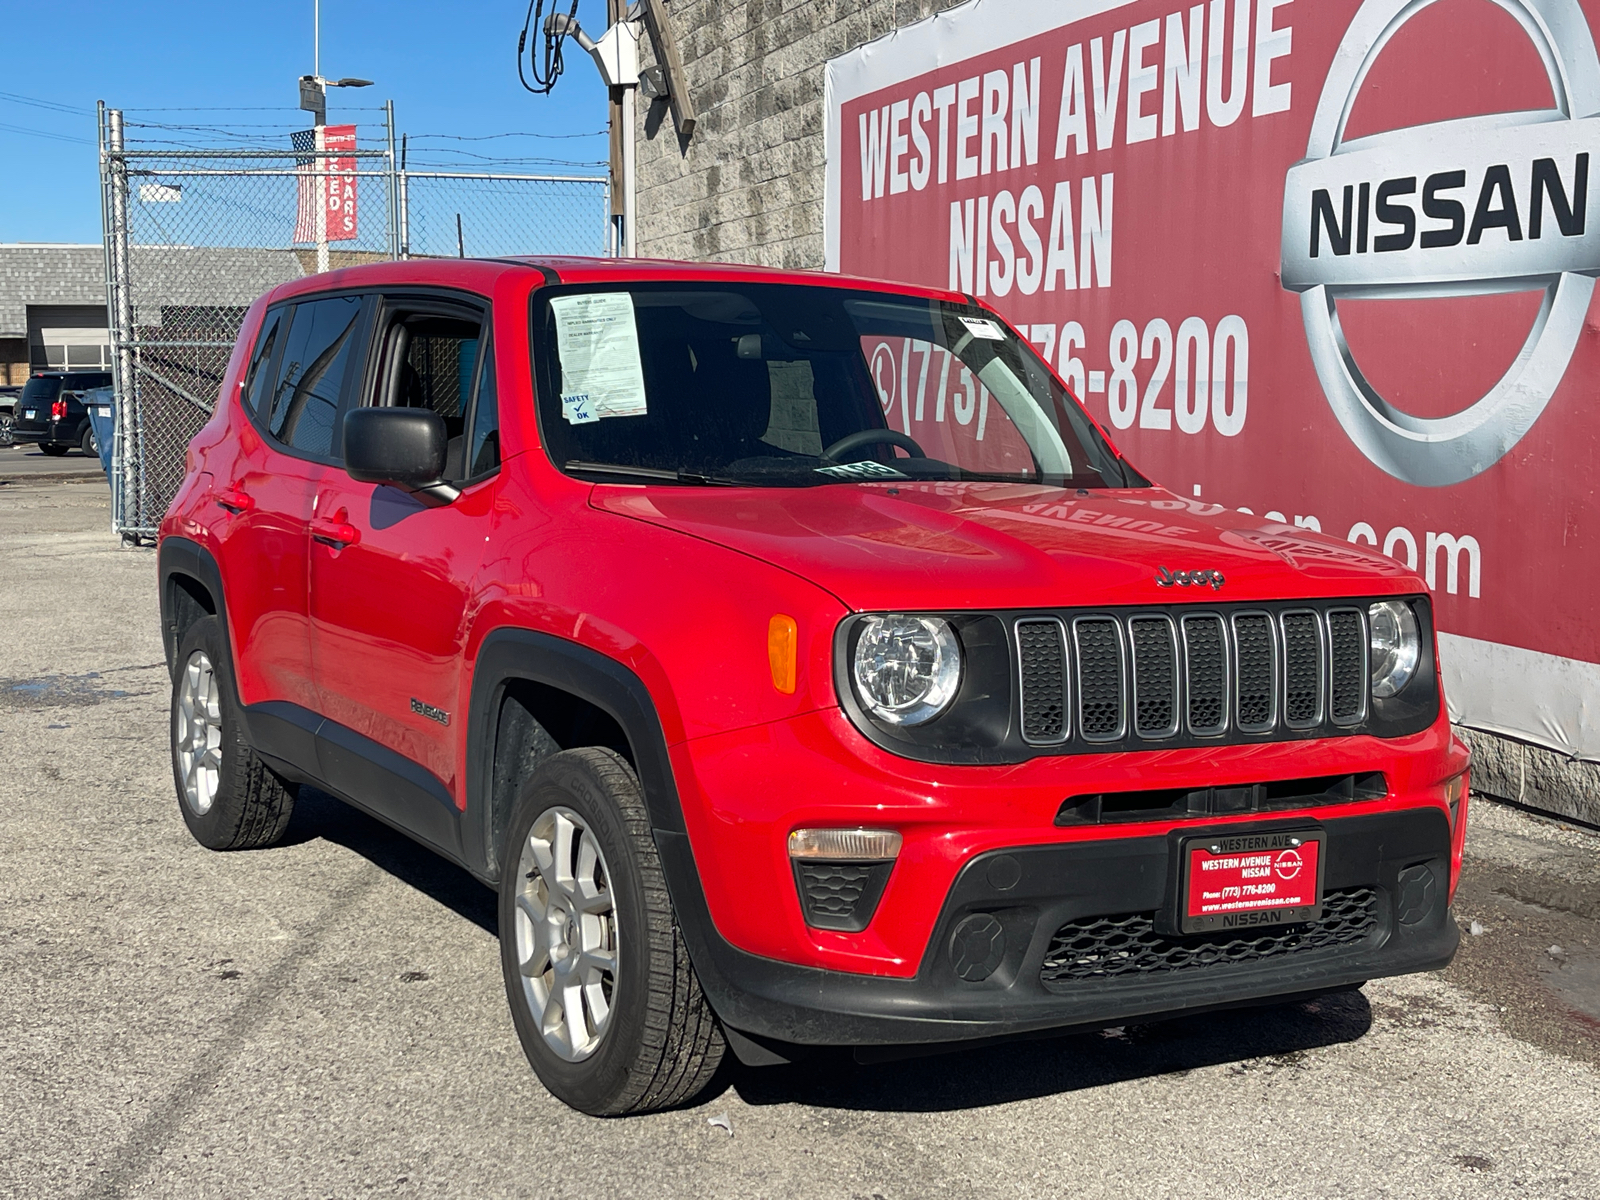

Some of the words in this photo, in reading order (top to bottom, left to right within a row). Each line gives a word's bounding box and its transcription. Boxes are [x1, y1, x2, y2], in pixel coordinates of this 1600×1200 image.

[859, 57, 1041, 201] WESTERN
[1055, 0, 1294, 159] AVENUE
[328, 147, 341, 211] USED
[343, 168, 354, 232] CARS
[1309, 152, 1589, 258] NISSAN
[949, 172, 1114, 297] NISSAN
[563, 394, 589, 404] SAFETY
[576, 411, 590, 420] OK
[1154, 565, 1226, 591] Jeep
[1220, 837, 1268, 851] WESTERN
[1202, 858, 1239, 871] WESTERN
[1240, 855, 1271, 868] AVENUE
[1241, 866, 1271, 878] NISSAN
[1202, 891, 1221, 900] Phone:
[1221, 886, 1241, 900] (773)
[1242, 883, 1276, 896] 776-8200
[1202, 896, 1301, 912] www.westernavenissan.com
[1222, 911, 1282, 927] NISSAN
